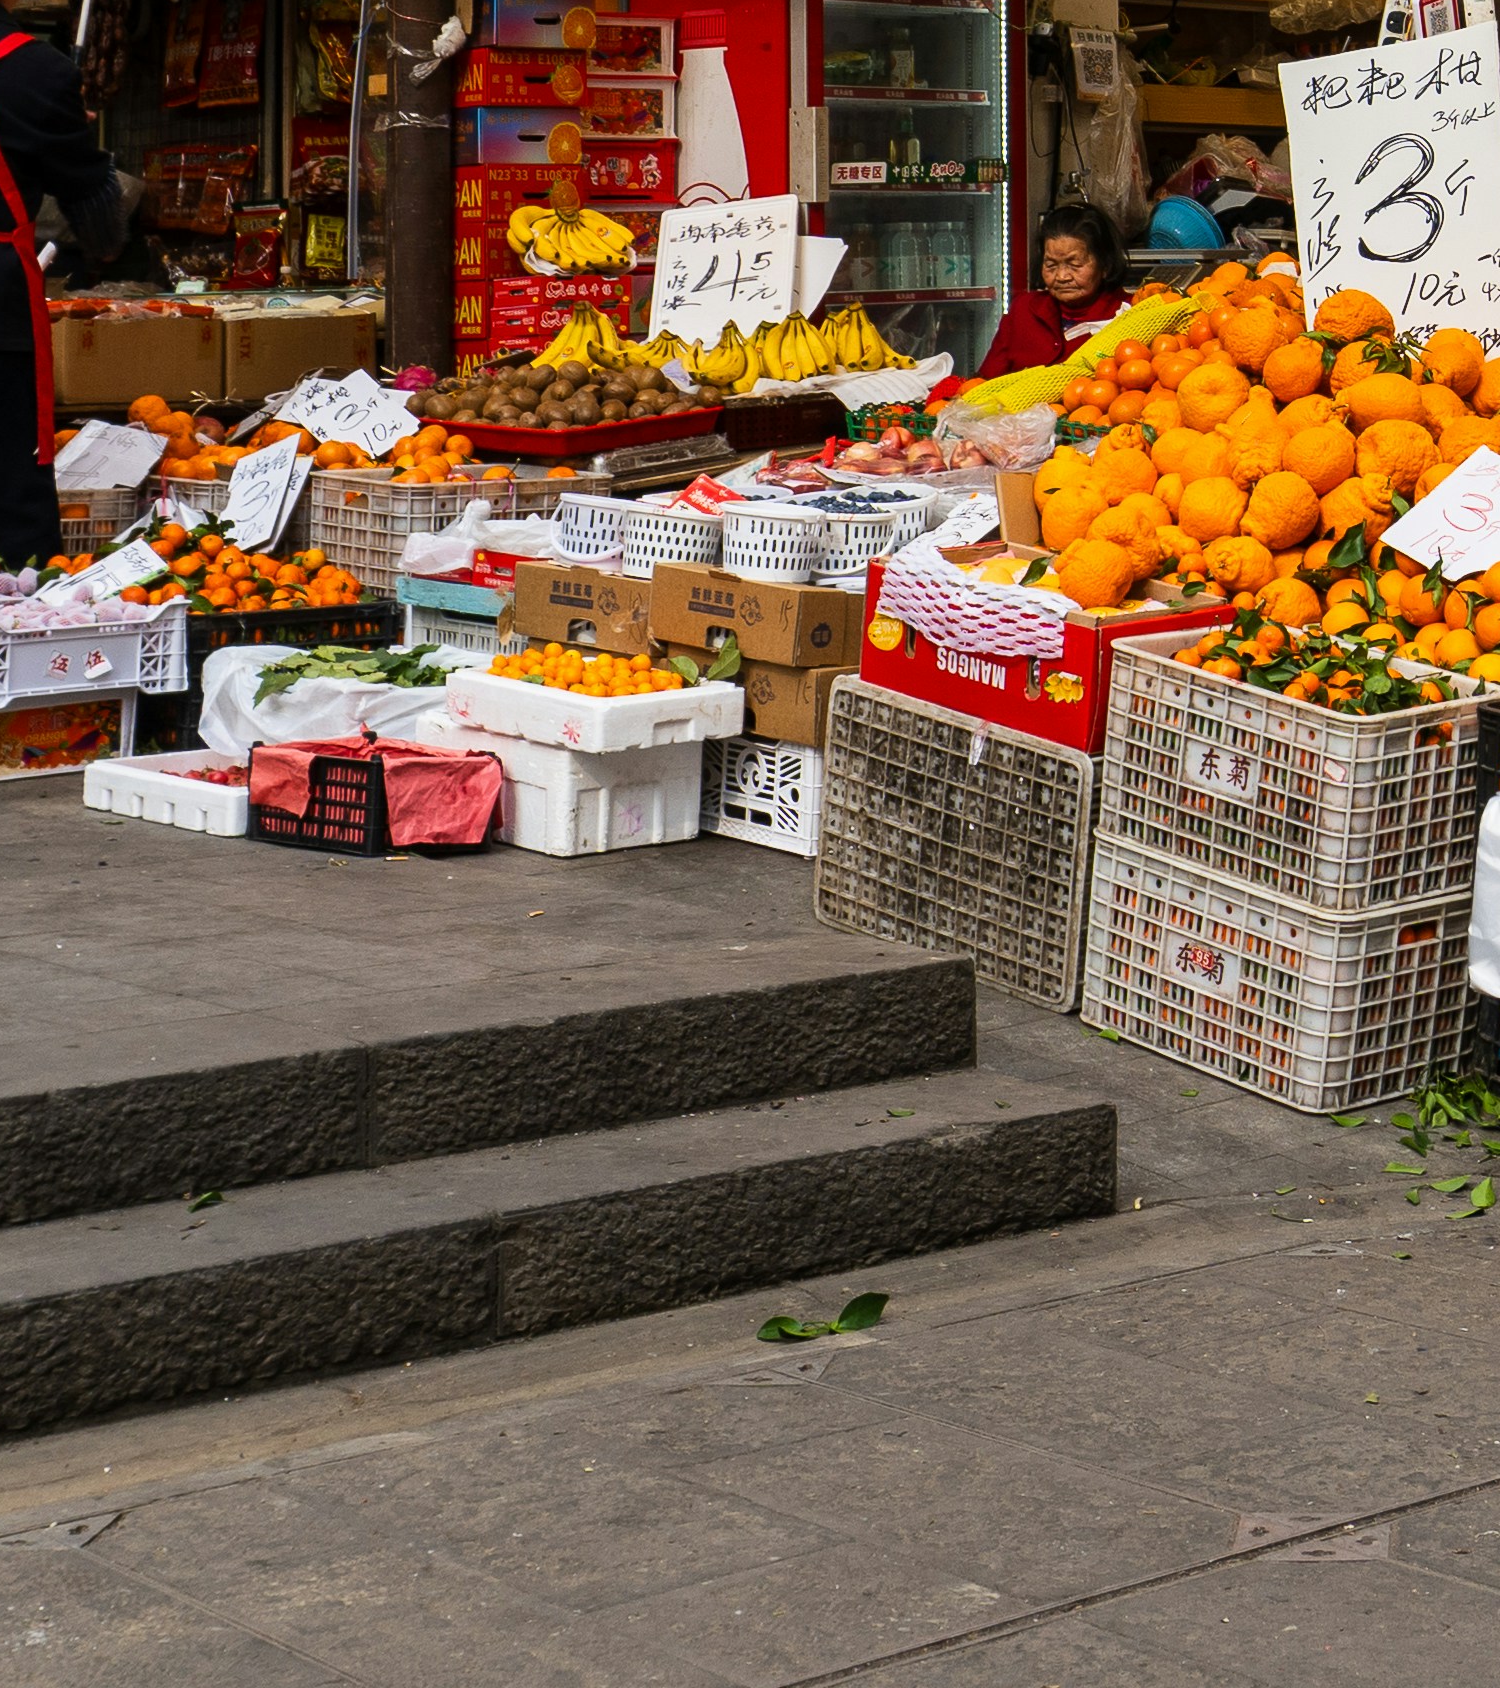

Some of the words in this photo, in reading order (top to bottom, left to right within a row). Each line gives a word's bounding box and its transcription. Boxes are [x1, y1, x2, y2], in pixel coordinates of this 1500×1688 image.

[551, 579, 593, 600] 新鲜蓝莓
[690, 586, 735, 608] 新鲜蓝莓
[936, 645, 1007, 691] MANGOS
[1198, 746, 1251, 793] 东菊
